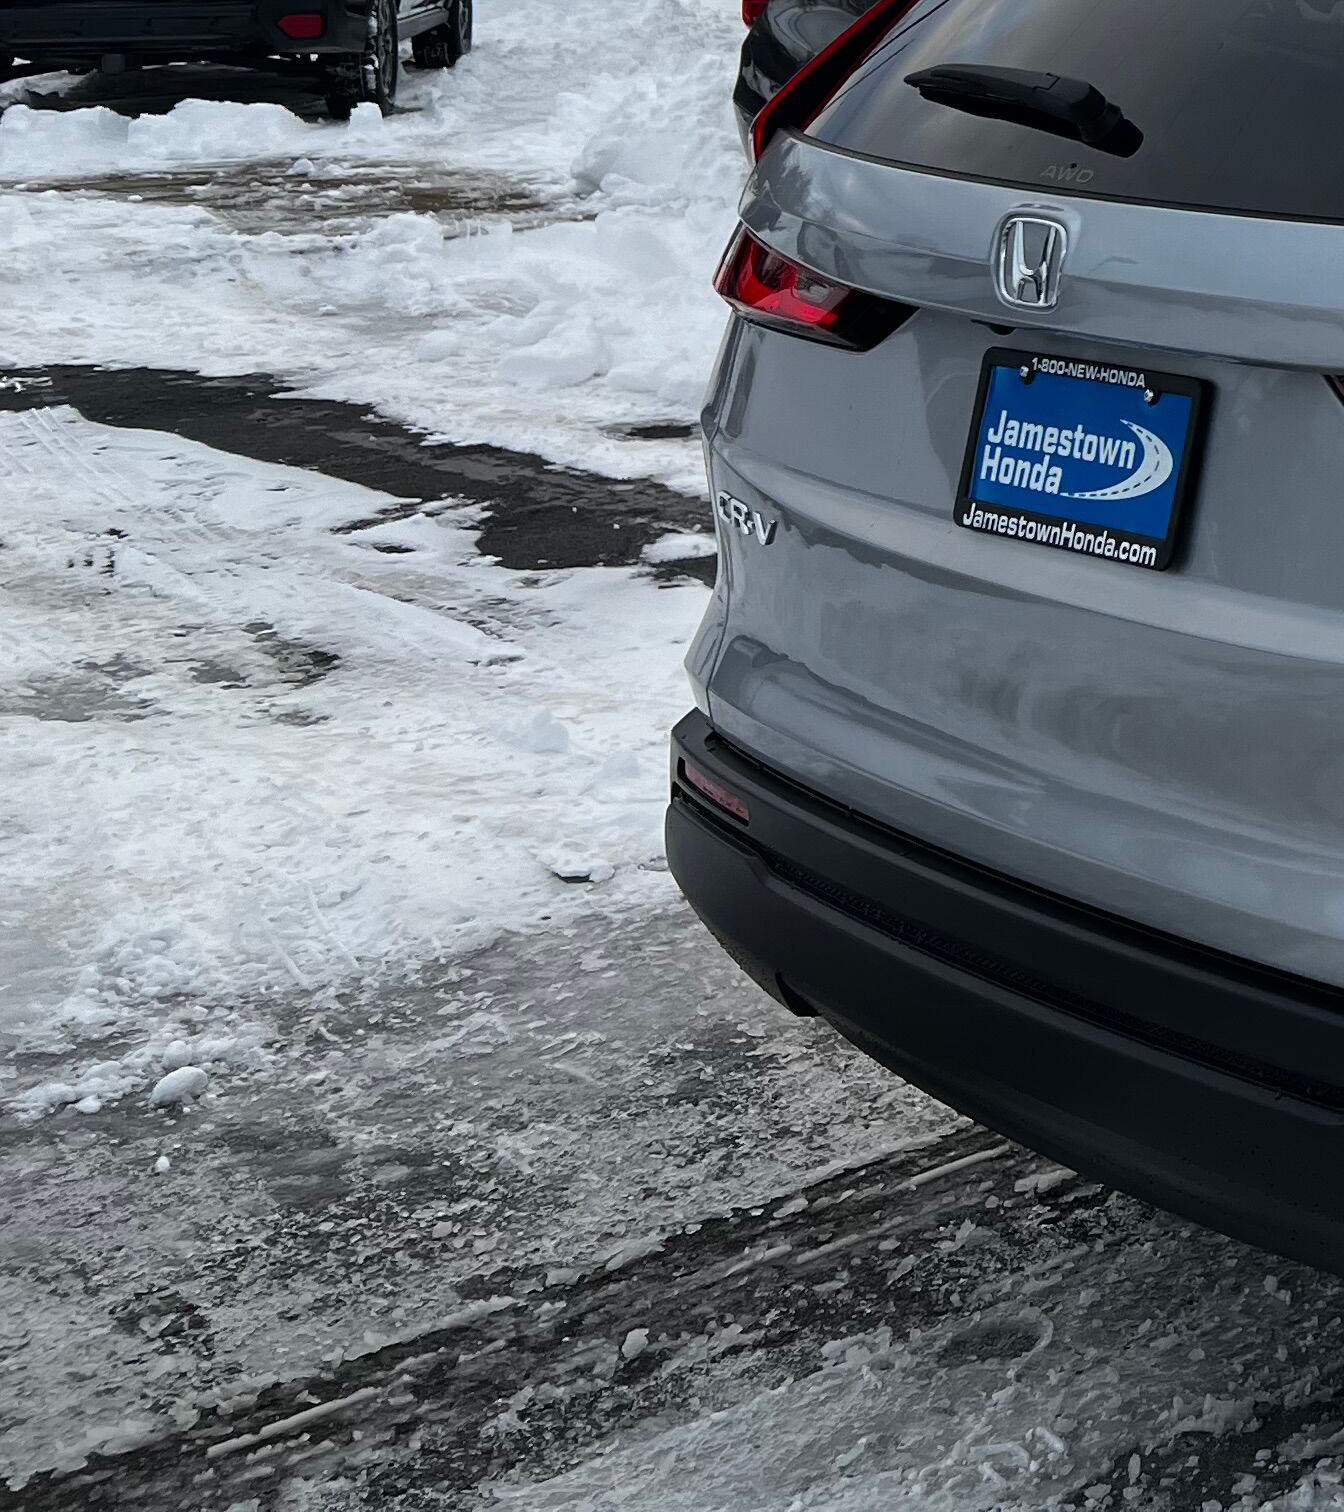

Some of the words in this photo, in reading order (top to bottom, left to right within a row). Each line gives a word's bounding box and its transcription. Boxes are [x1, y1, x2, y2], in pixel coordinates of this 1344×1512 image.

[1040, 165, 1094, 183] AWD
[1031, 357, 1146, 388] 1-800-NEW-HONDA
[987, 410, 1136, 469] Jamestown
[980, 444, 1063, 495] Honda
[718, 490, 778, 546] CR-V
[962, 502, 1157, 567] JamestownHonda.com
